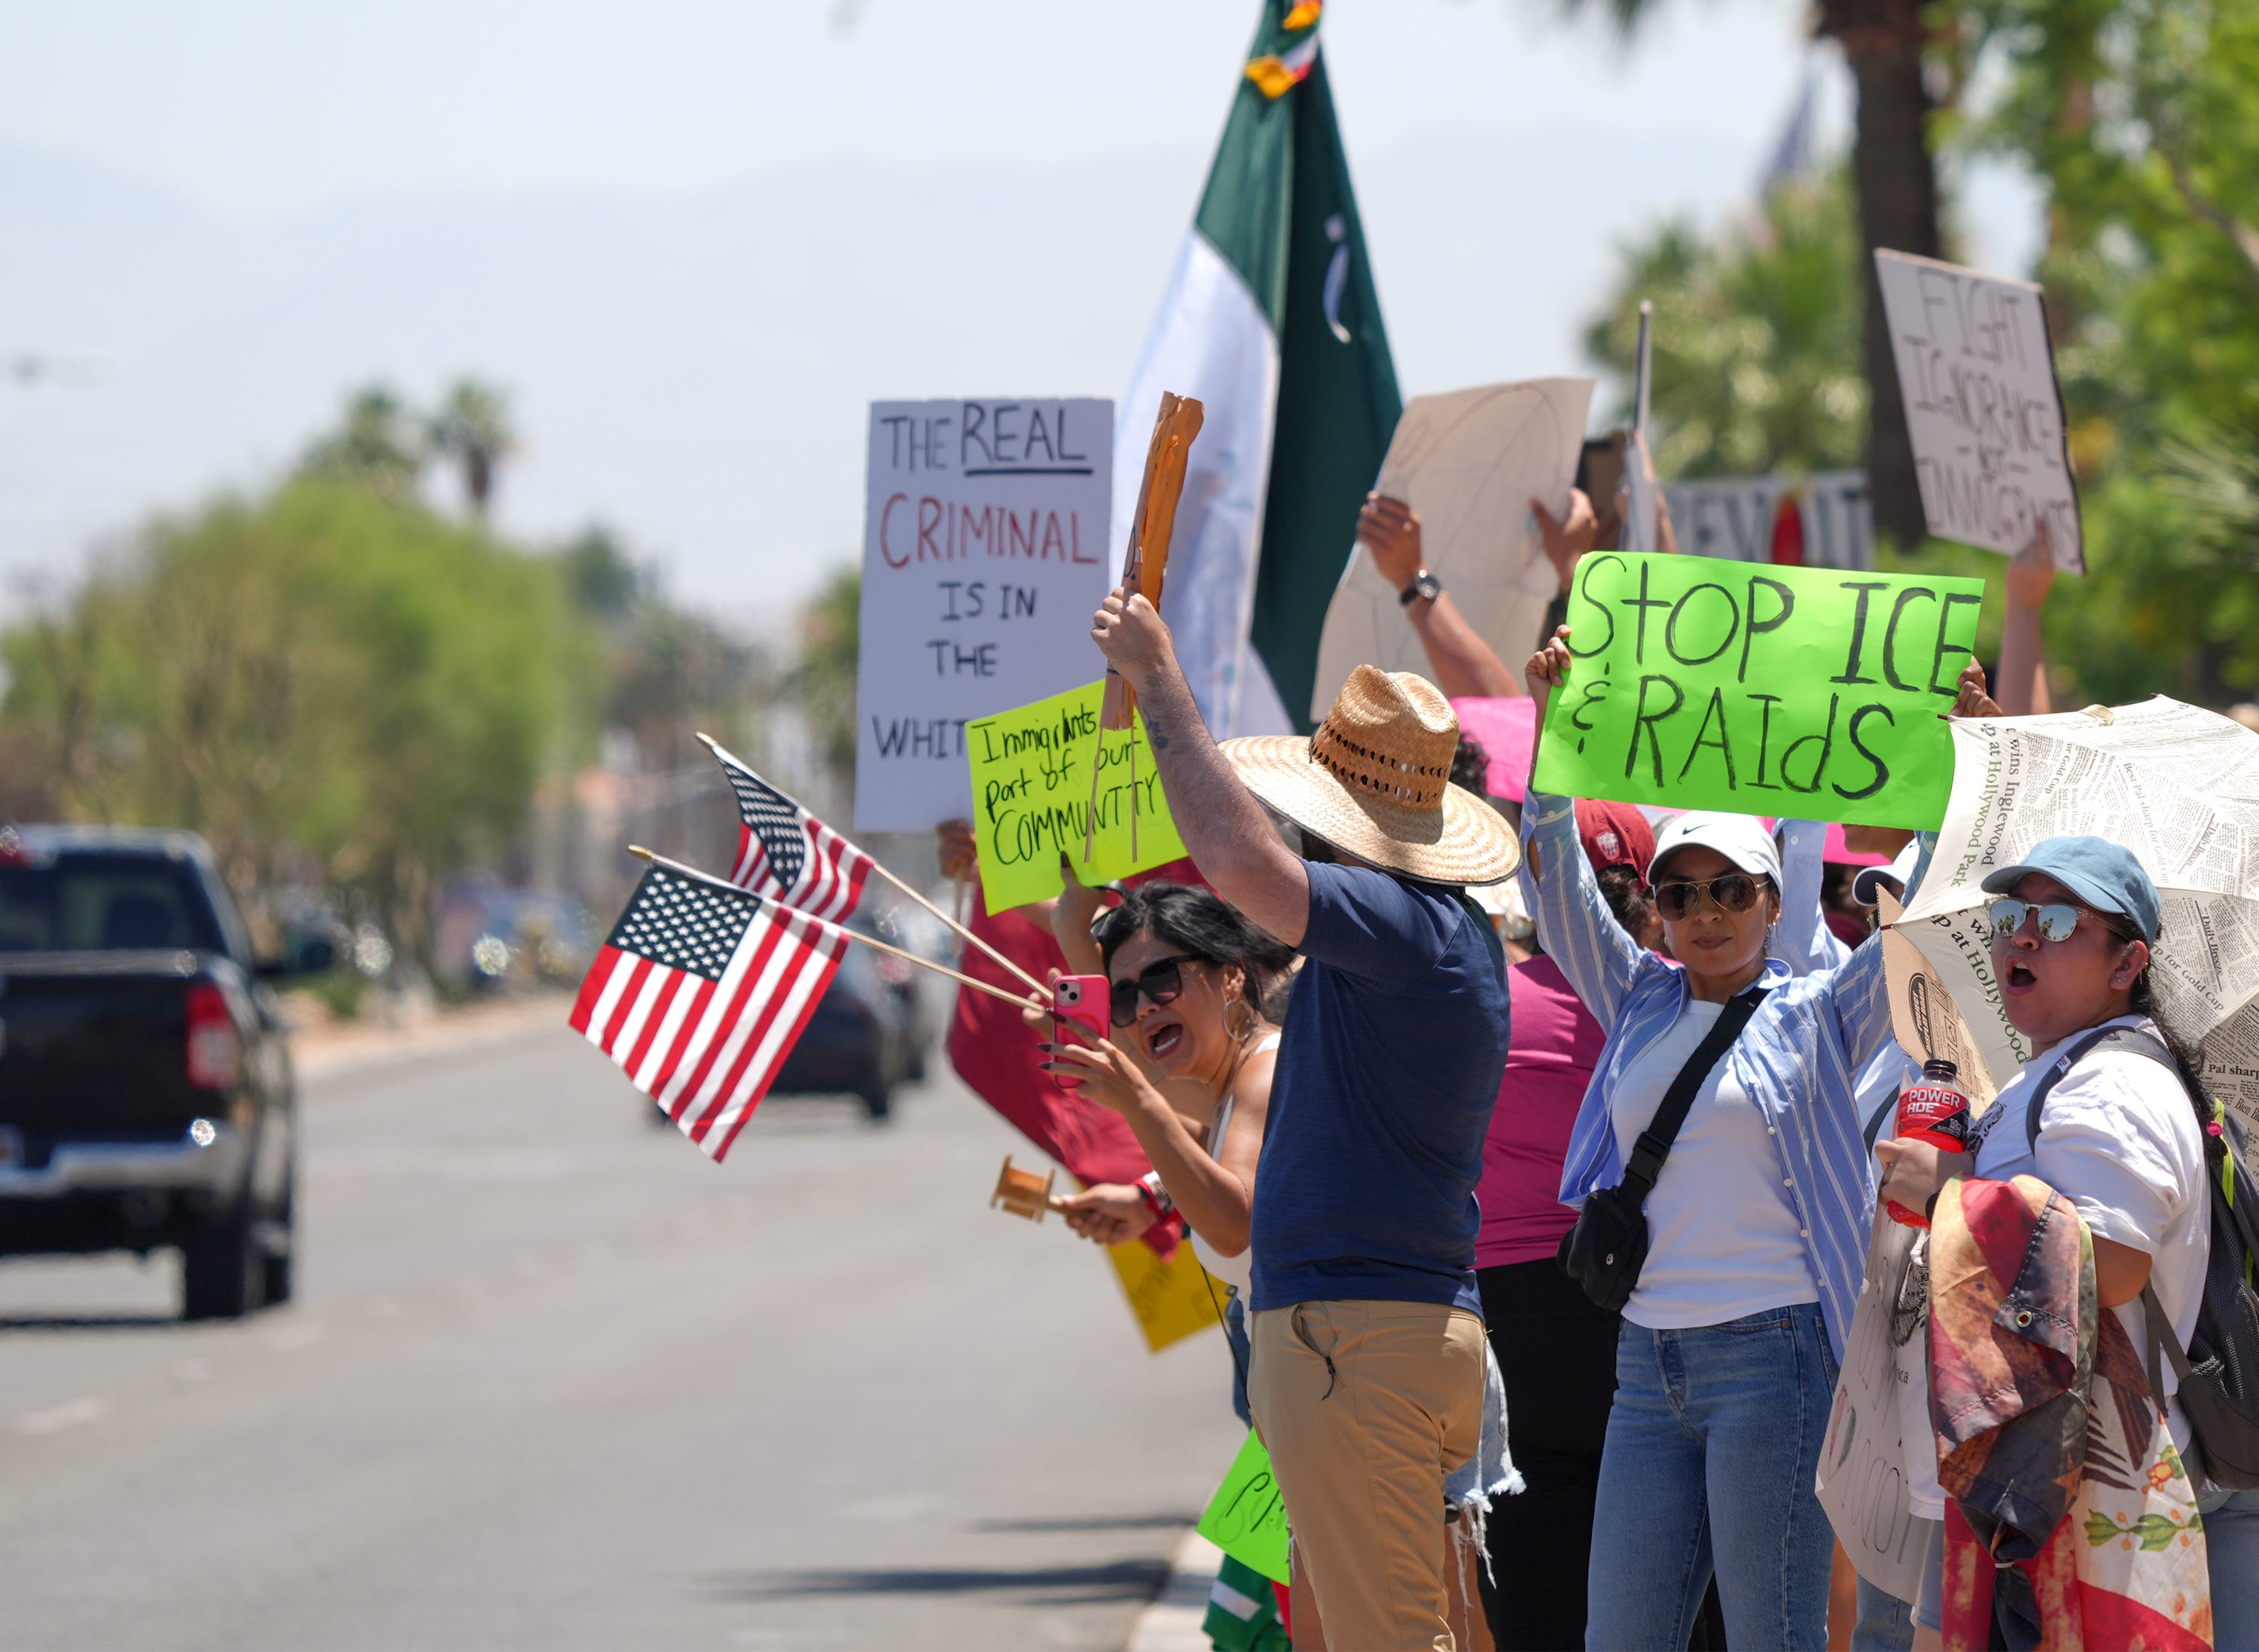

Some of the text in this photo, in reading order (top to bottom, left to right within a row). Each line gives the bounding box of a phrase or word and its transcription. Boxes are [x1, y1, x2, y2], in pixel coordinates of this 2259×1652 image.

[880, 402, 1087, 472] THE REAL
[879, 492, 1099, 569] CRIMINAL
[937, 581, 1037, 622] IS IN
[925, 639, 1000, 677] THE
[1830, 582, 1982, 697] ICE
[871, 715, 968, 760] WHIT
[1989, 741, 2001, 757] at
[2008, 737, 2024, 776] wins
[2046, 777, 2059, 794] Cup
[2056, 755, 2071, 776] Gold
[1968, 760, 2002, 848] Hollywood
[1980, 781, 2020, 866] Inglewood
[2123, 762, 2169, 884] Best Pal sharp for Gold Cup
[2200, 825, 2217, 846] Daily
[1951, 854, 1977, 887] Park
[2203, 916, 2223, 977] Daily Breeze
[1951, 931, 1971, 950] at
[1966, 949, 2031, 1065] Hollywood
[2164, 953, 2181, 971] for
[2182, 970, 2207, 993] Gold
[2206, 992, 2224, 1010] Cup
[1913, 989, 1923, 1032] PROJECT
[1918, 982, 1932, 1054] DISPLAY BOARD
[2209, 1064, 2226, 1074] Pal
[1907, 1102, 1934, 1113] ADE
[1909, 1090, 1960, 1108] POWER
[2235, 1098, 2251, 1115] Bien
